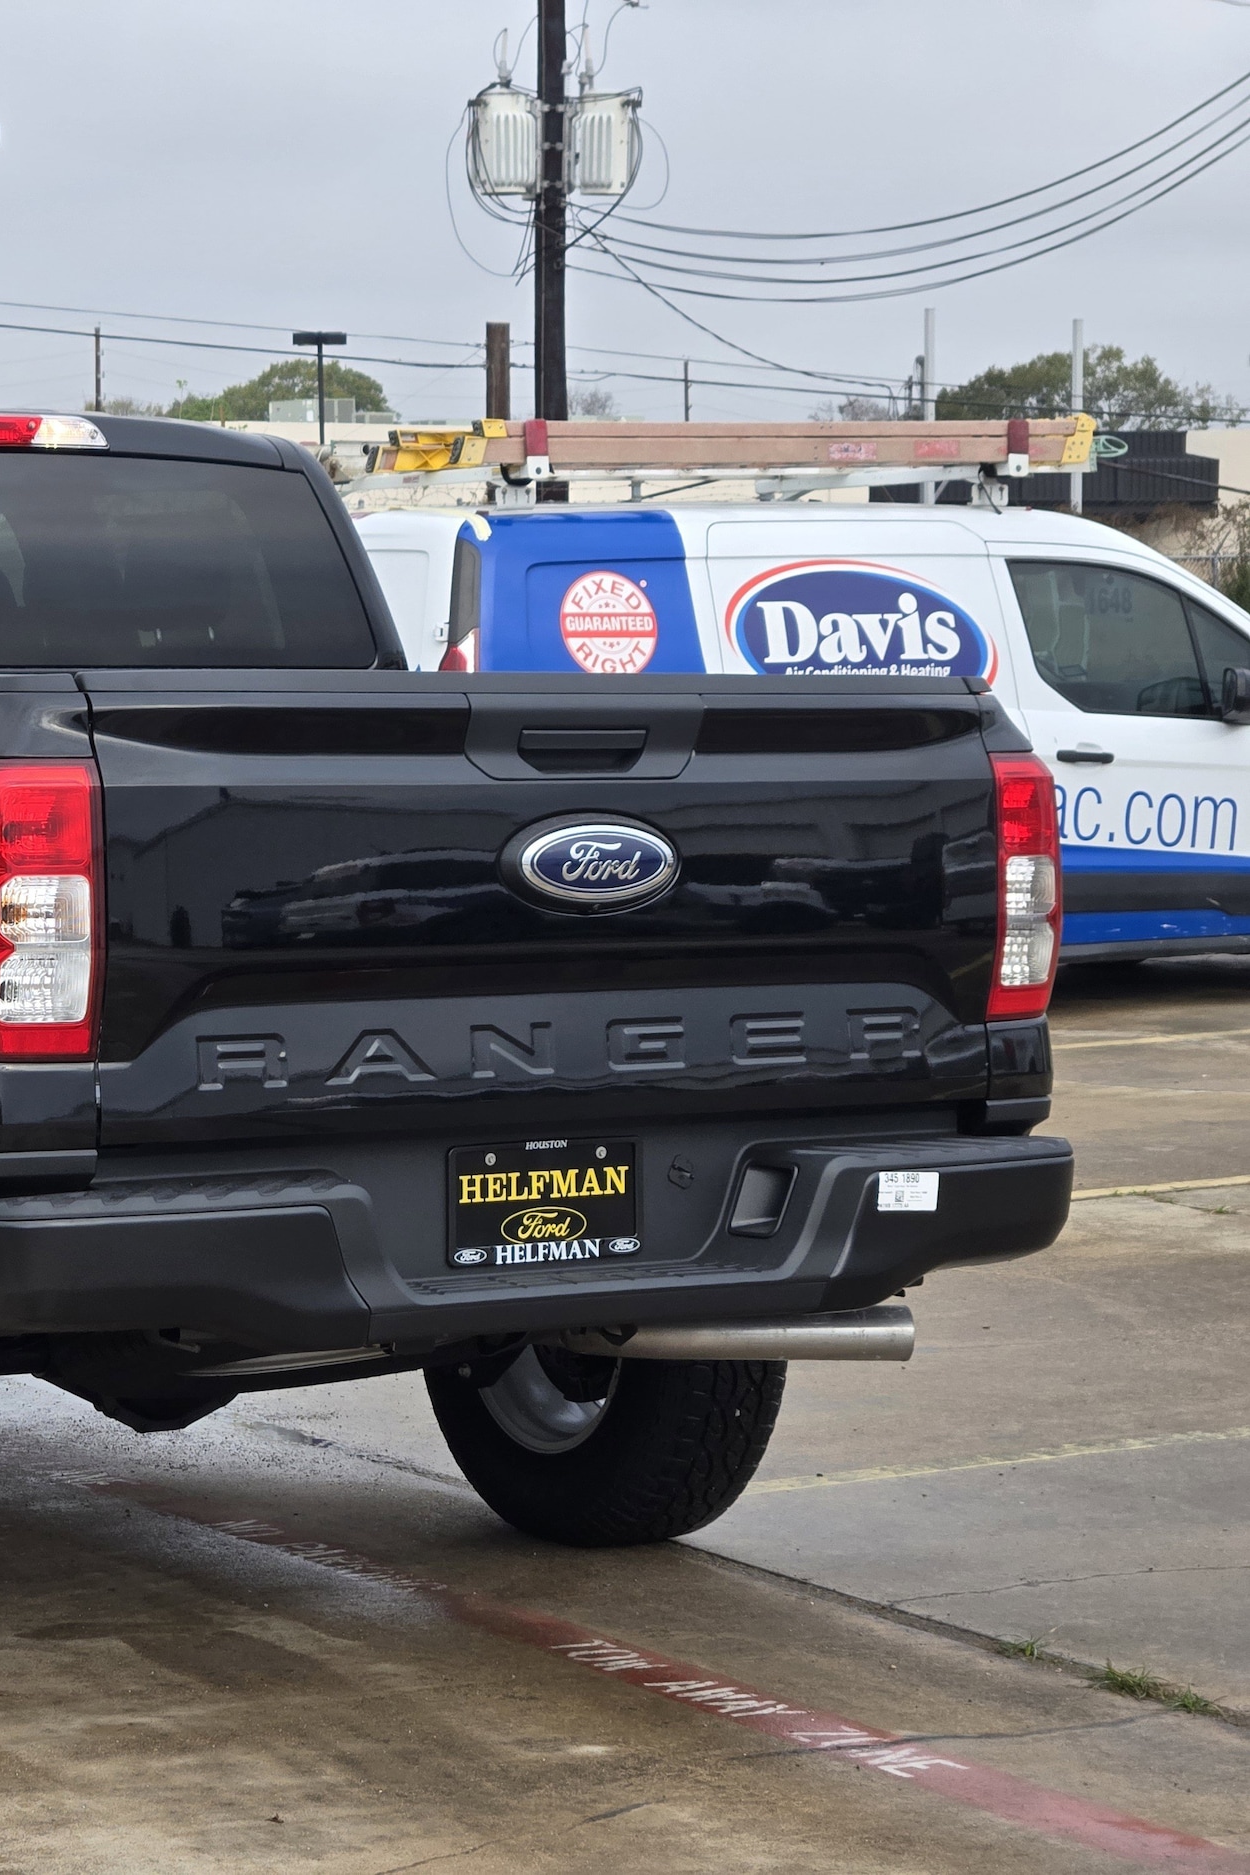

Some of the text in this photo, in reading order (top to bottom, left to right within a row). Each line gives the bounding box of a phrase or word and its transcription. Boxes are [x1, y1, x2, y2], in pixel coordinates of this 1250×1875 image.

[570, 578, 642, 611] FIXED
[564, 615, 654, 632] GUARANTEED
[756, 592, 961, 664] Davis
[575, 640, 647, 674] RIGHT
[561, 840, 642, 882] Ford
[195, 1007, 923, 1091] RANGER
[525, 1139, 568, 1151] HOUSTON
[458, 1165, 630, 1204] HELFMAN
[884, 1173, 920, 1184] 345 1890
[517, 1211, 572, 1240] Ford
[459, 1238, 637, 1265] Ford HELFMAN Ford
[550, 1638, 669, 1672] TOW
[642, 1679, 809, 1718] AWAY
